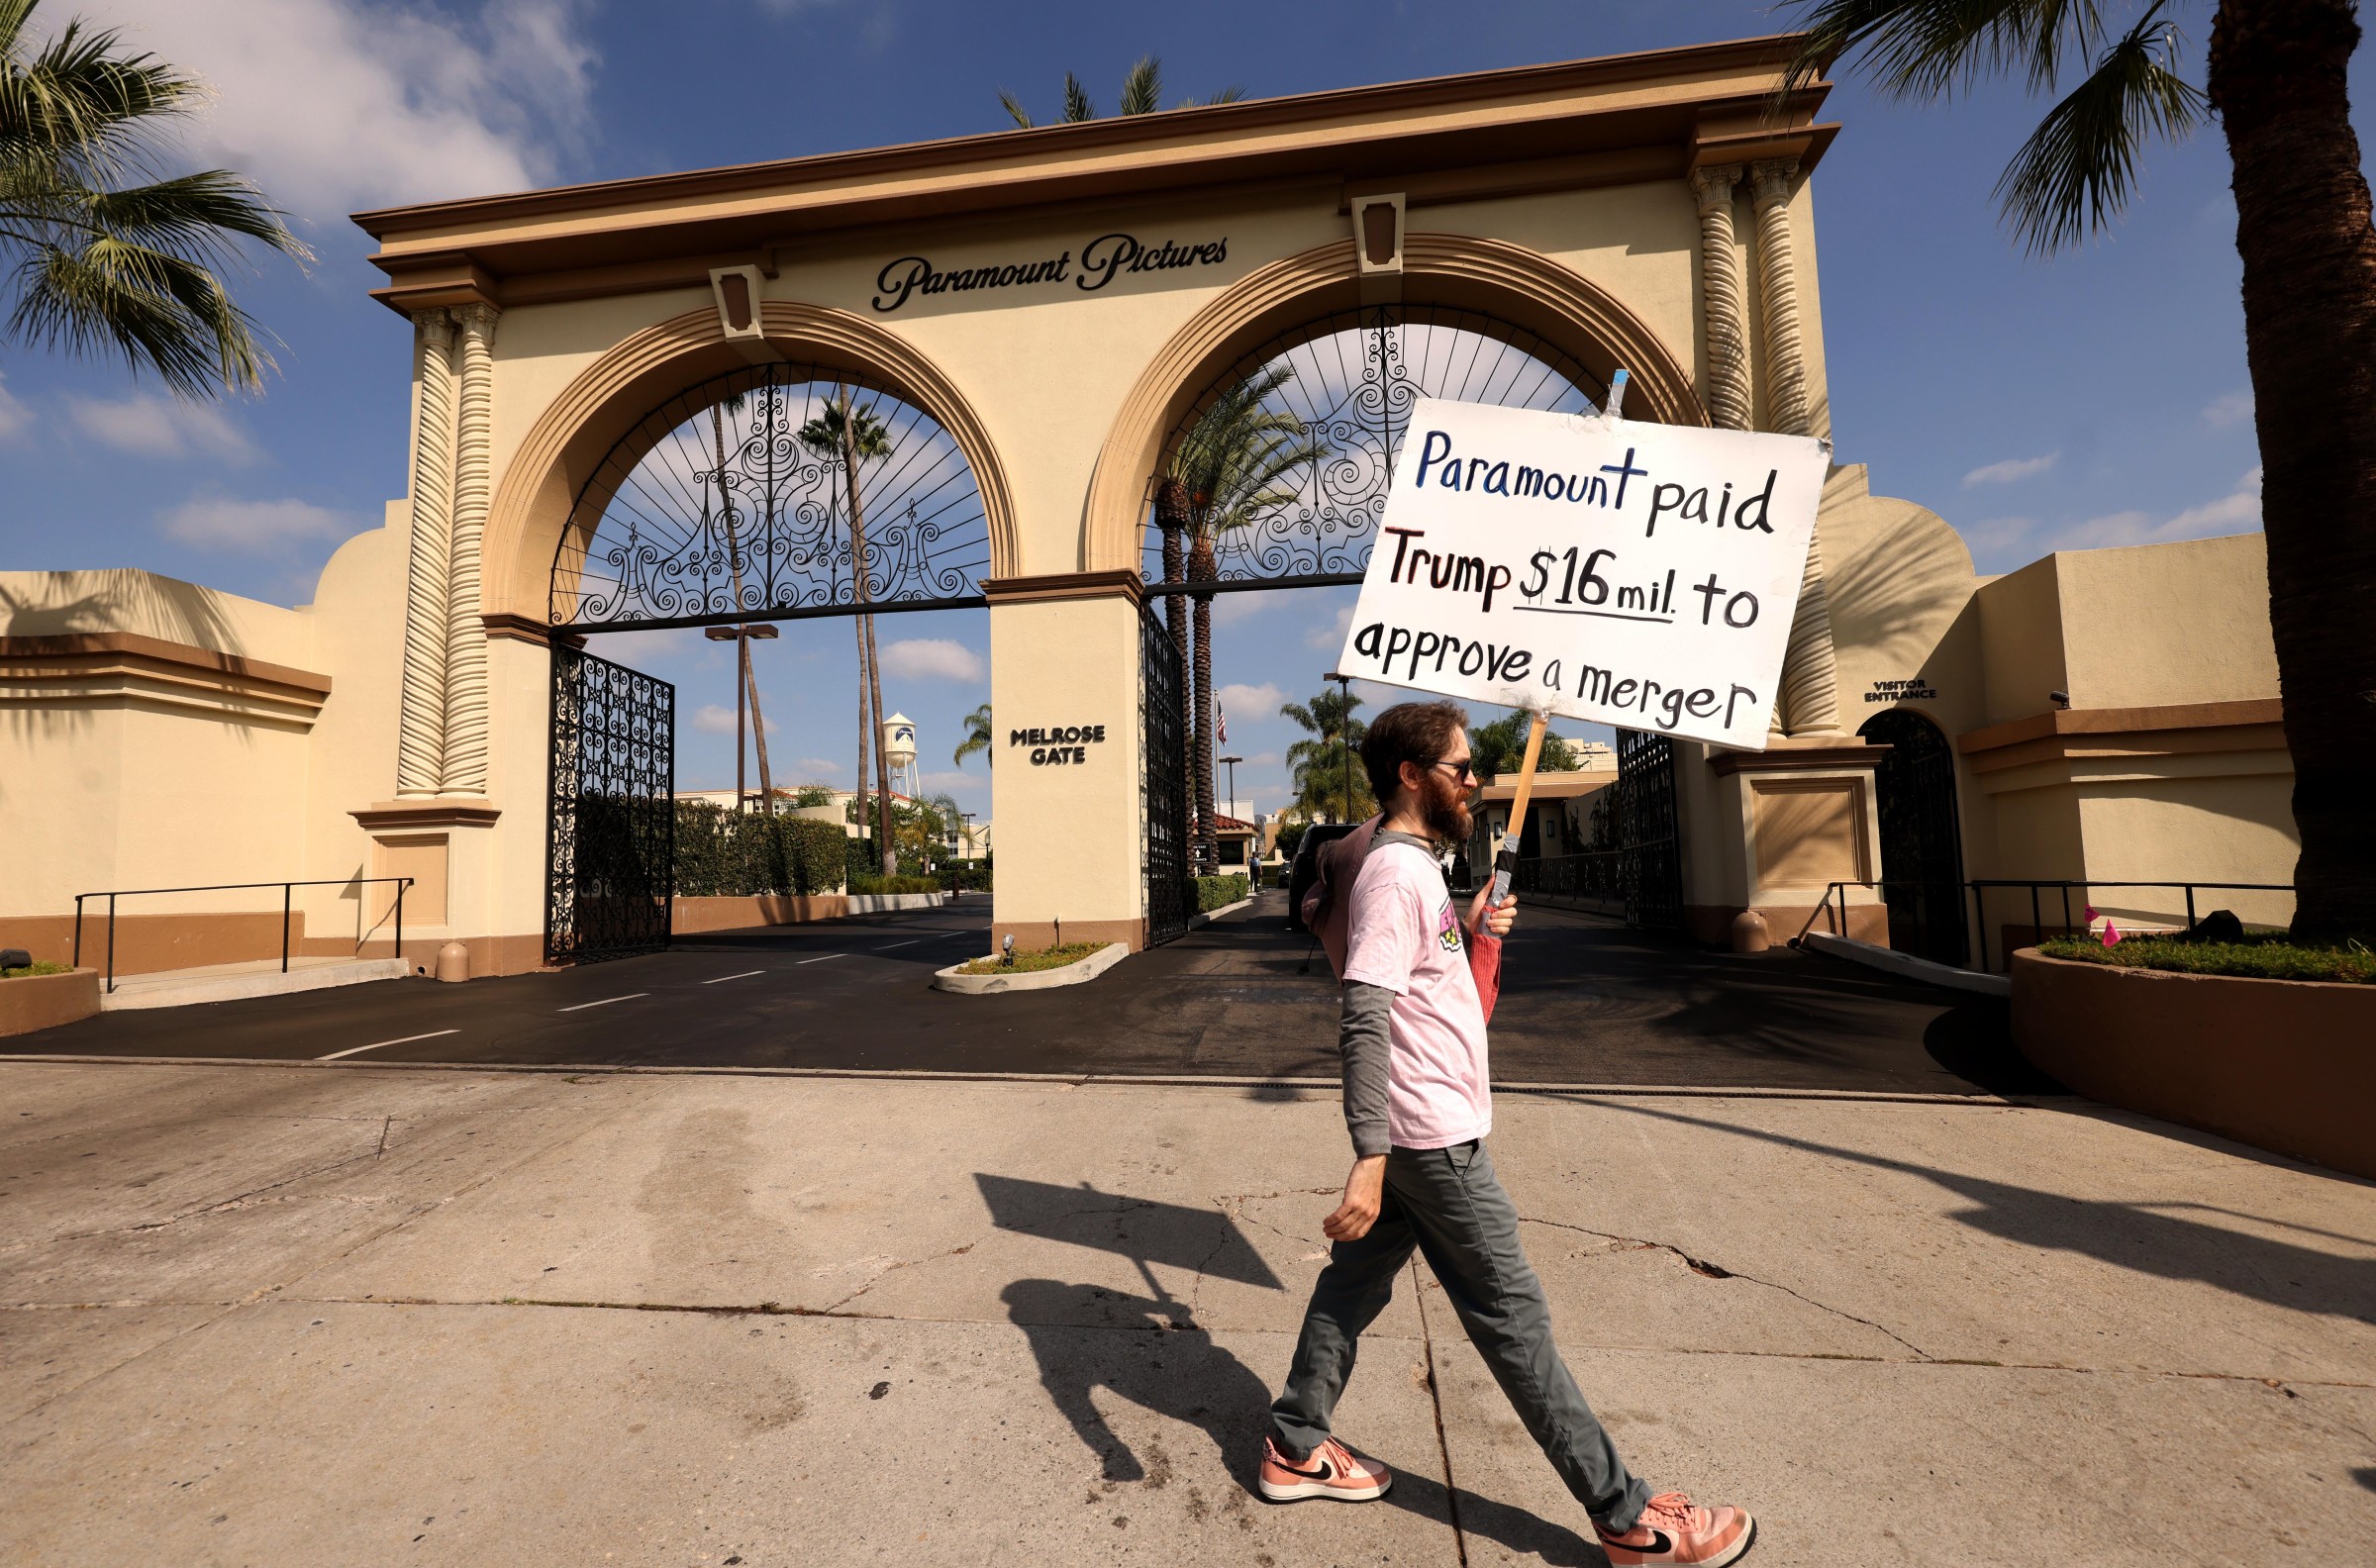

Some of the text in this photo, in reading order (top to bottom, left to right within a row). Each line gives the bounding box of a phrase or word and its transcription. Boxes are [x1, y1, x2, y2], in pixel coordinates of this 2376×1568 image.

[872, 234, 1228, 312] Paramount Pictures
[1416, 431, 1778, 538] Paramount paid
[1385, 527, 1759, 629] Trump $16 mil. to
[1354, 623, 1757, 730] approve a merger
[1864, 690, 1936, 703] ENTRANCE
[1873, 680, 1926, 691] VISITOR
[1010, 725, 1105, 747] MELROSE
[1030, 746, 1086, 767] GATE
